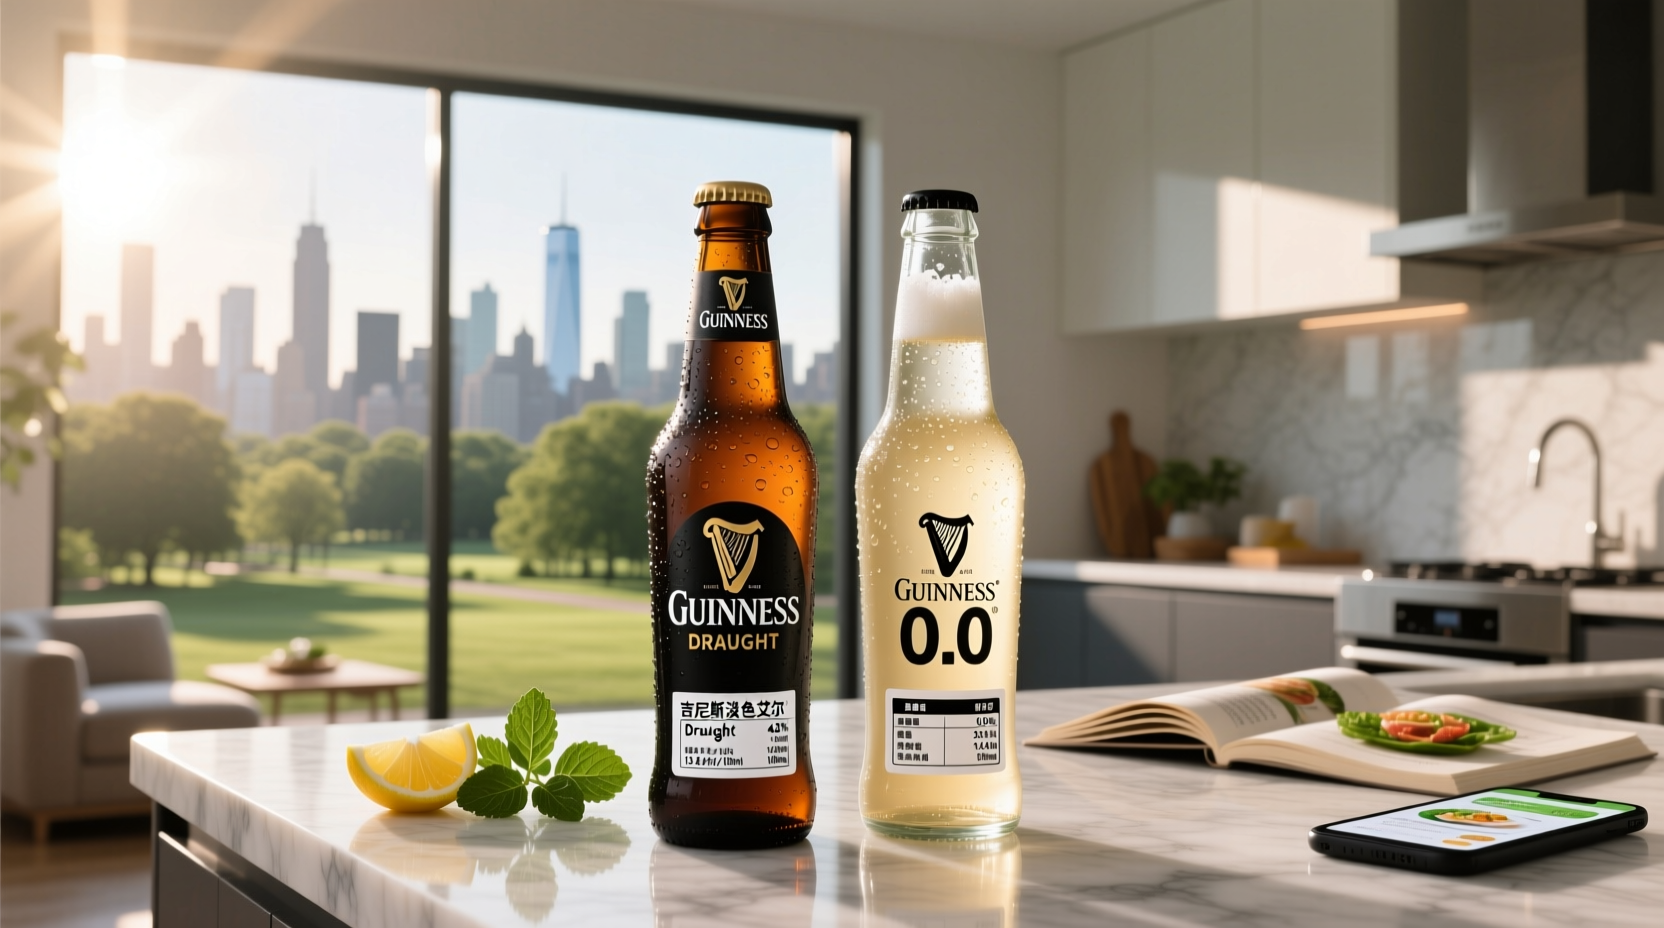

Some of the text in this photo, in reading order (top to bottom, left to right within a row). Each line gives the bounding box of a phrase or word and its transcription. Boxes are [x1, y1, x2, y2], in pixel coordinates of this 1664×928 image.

[699, 310, 768, 329] GUINNESS
[668, 589, 800, 626] GUINNESS
[688, 632, 779, 651] DRAUGHT
[900, 606, 993, 665] 0.0
